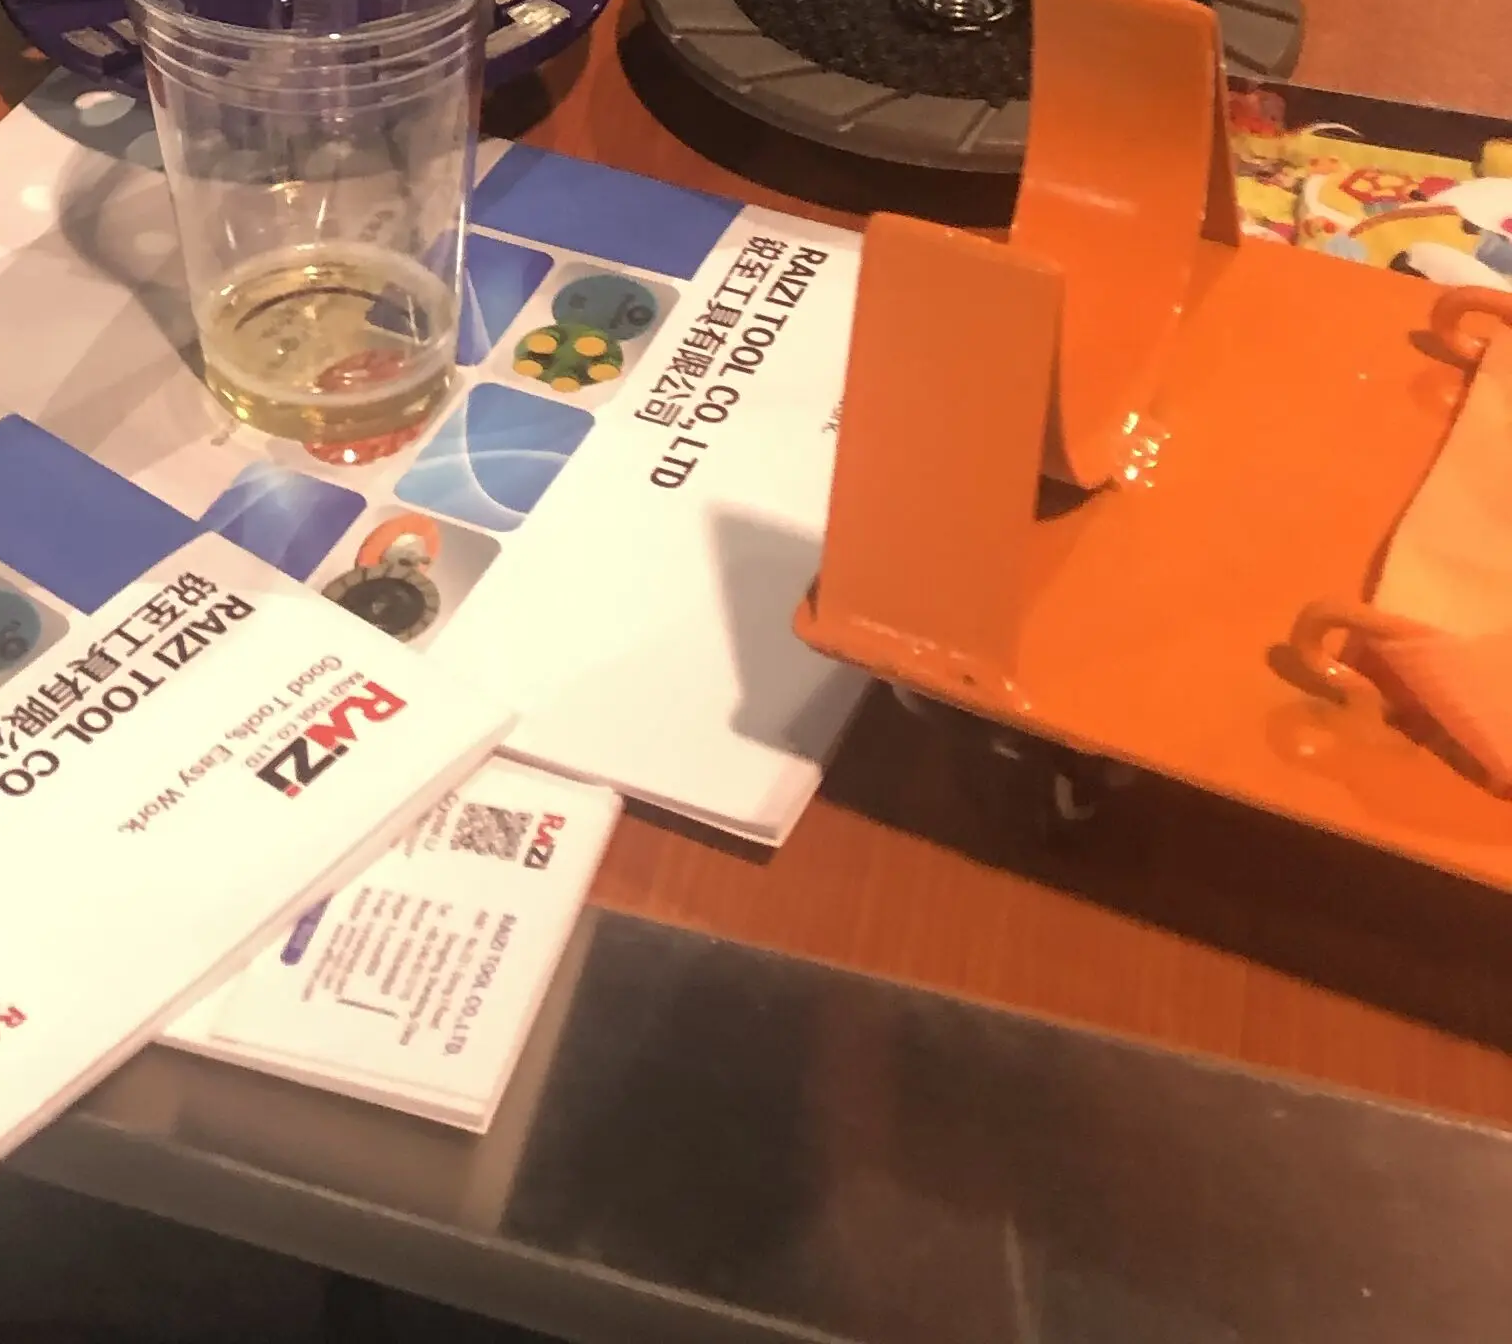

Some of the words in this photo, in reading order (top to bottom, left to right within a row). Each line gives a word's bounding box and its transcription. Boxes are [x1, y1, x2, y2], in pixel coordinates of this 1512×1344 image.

[765, 247, 829, 308] RAIZI
[634, 236, 789, 428] 锐至工具有限公司
[719, 313, 788, 376] TOOL
[650, 436, 708, 488] LTD
[153, 594, 256, 670] RAIZI
[286, 656, 342, 697] Good
[51, 670, 166, 744] TOOL
[225, 697, 292, 739] Tools,
[179, 744, 233, 787] Easy
[118, 788, 184, 832] Work.
